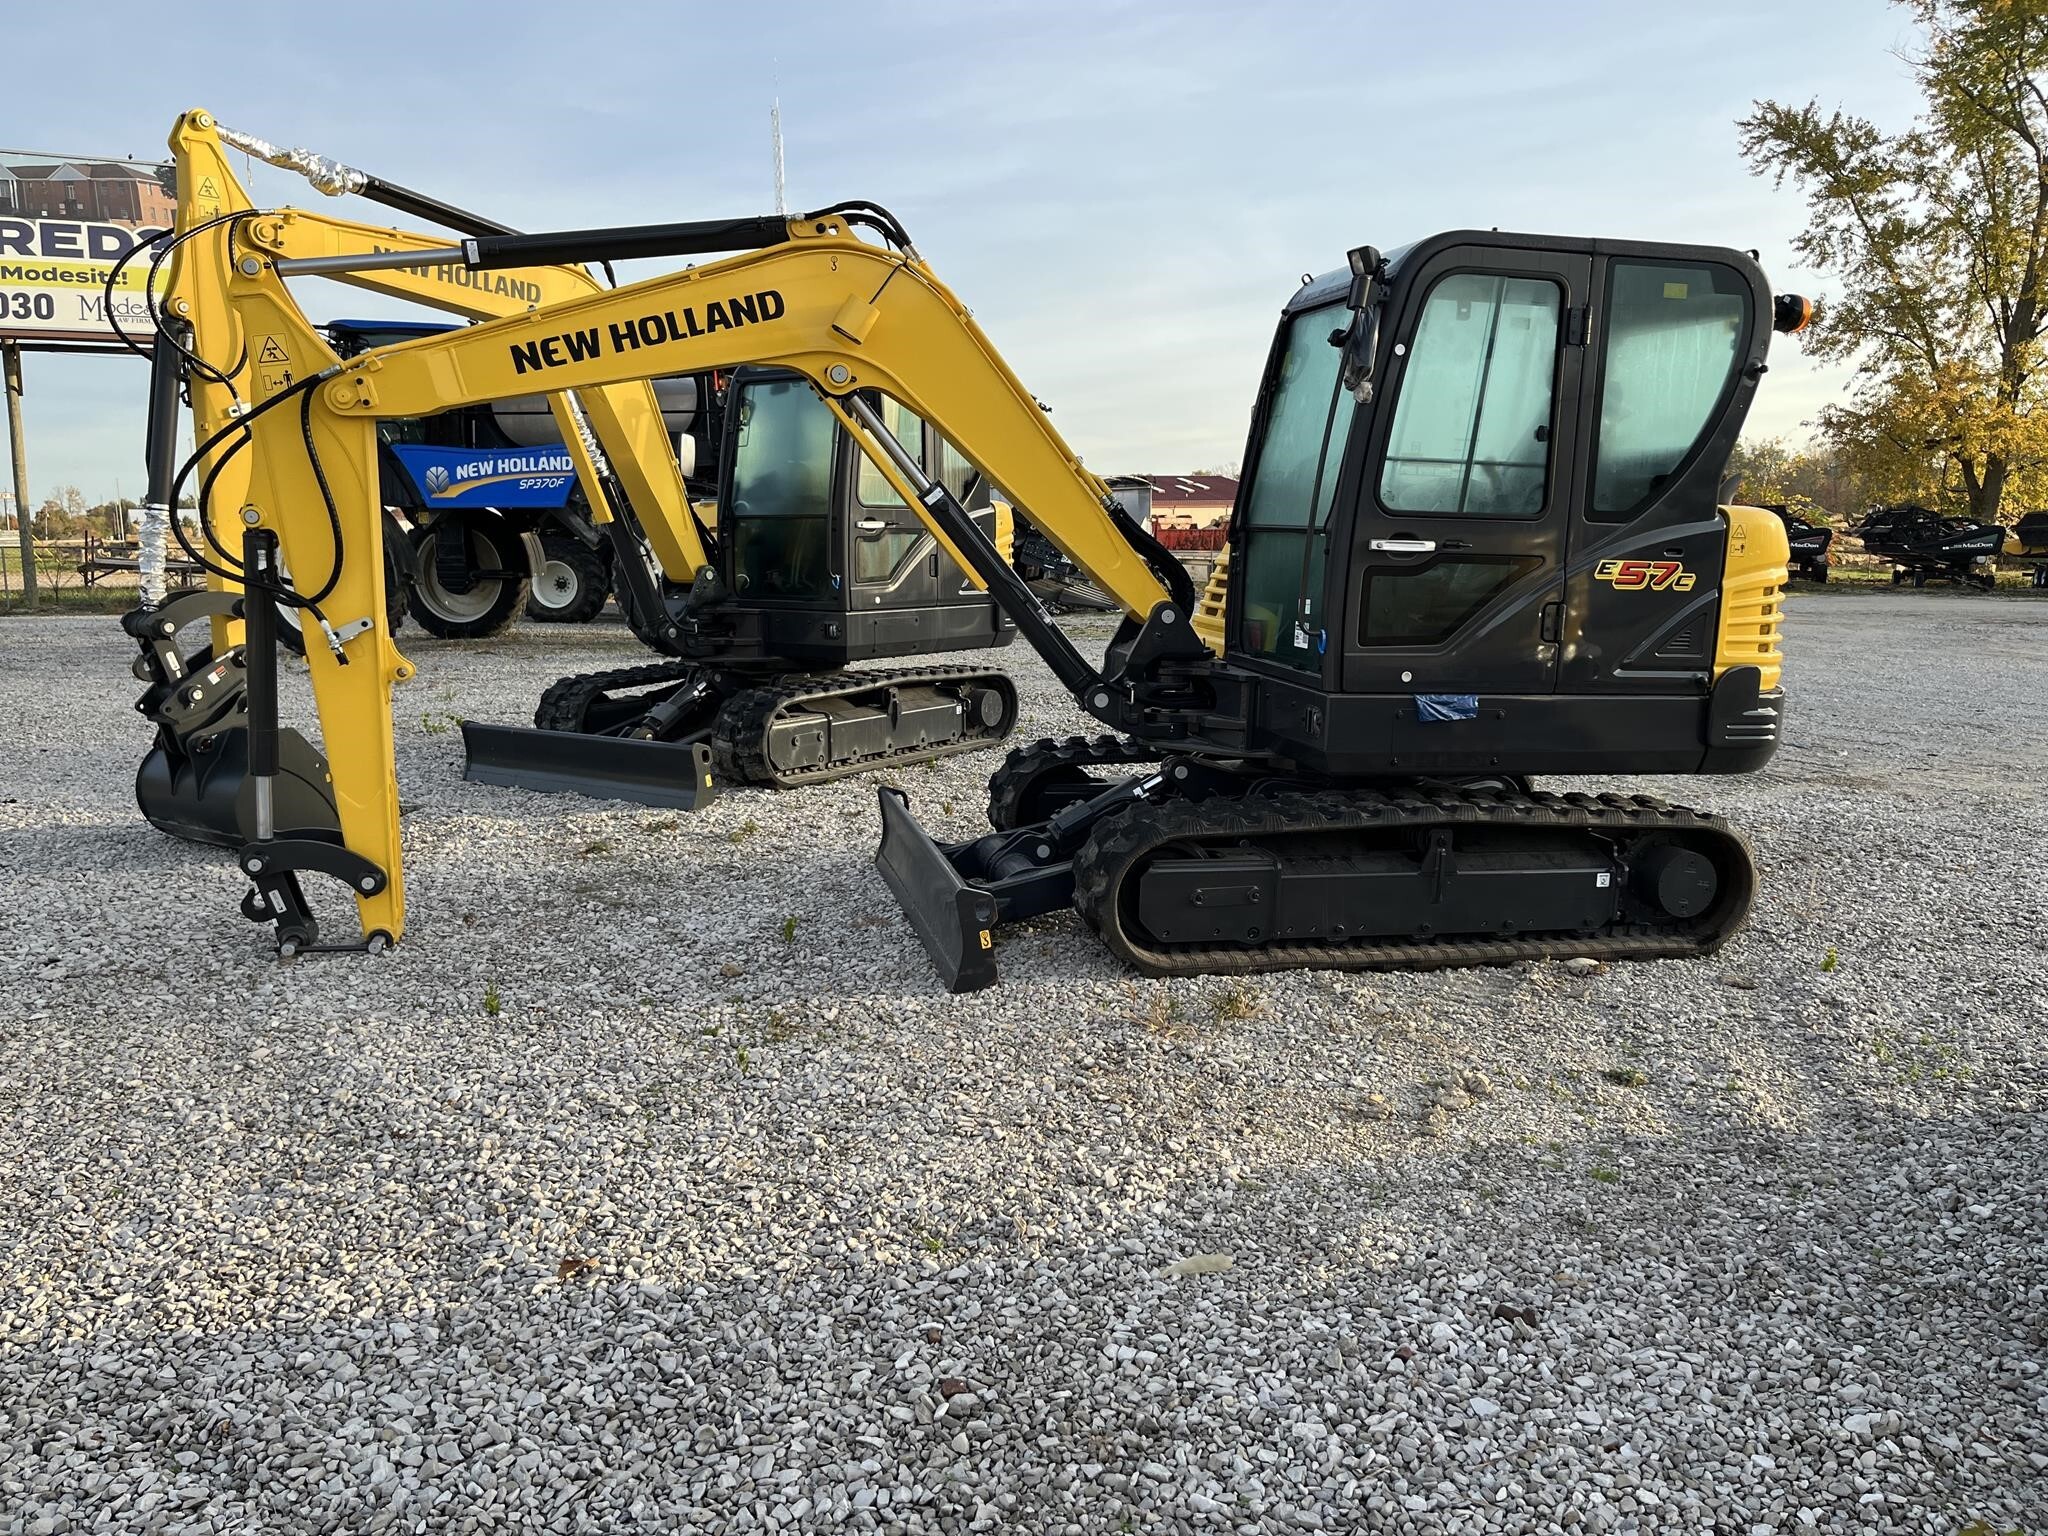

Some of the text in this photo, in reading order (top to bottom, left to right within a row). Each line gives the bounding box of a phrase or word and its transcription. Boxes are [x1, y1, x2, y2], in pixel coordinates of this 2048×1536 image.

[509, 290, 785, 375] NEW HOLLAND
[456, 456, 574, 480] NEW HOLLAND
[519, 477, 565, 490] SP370F
